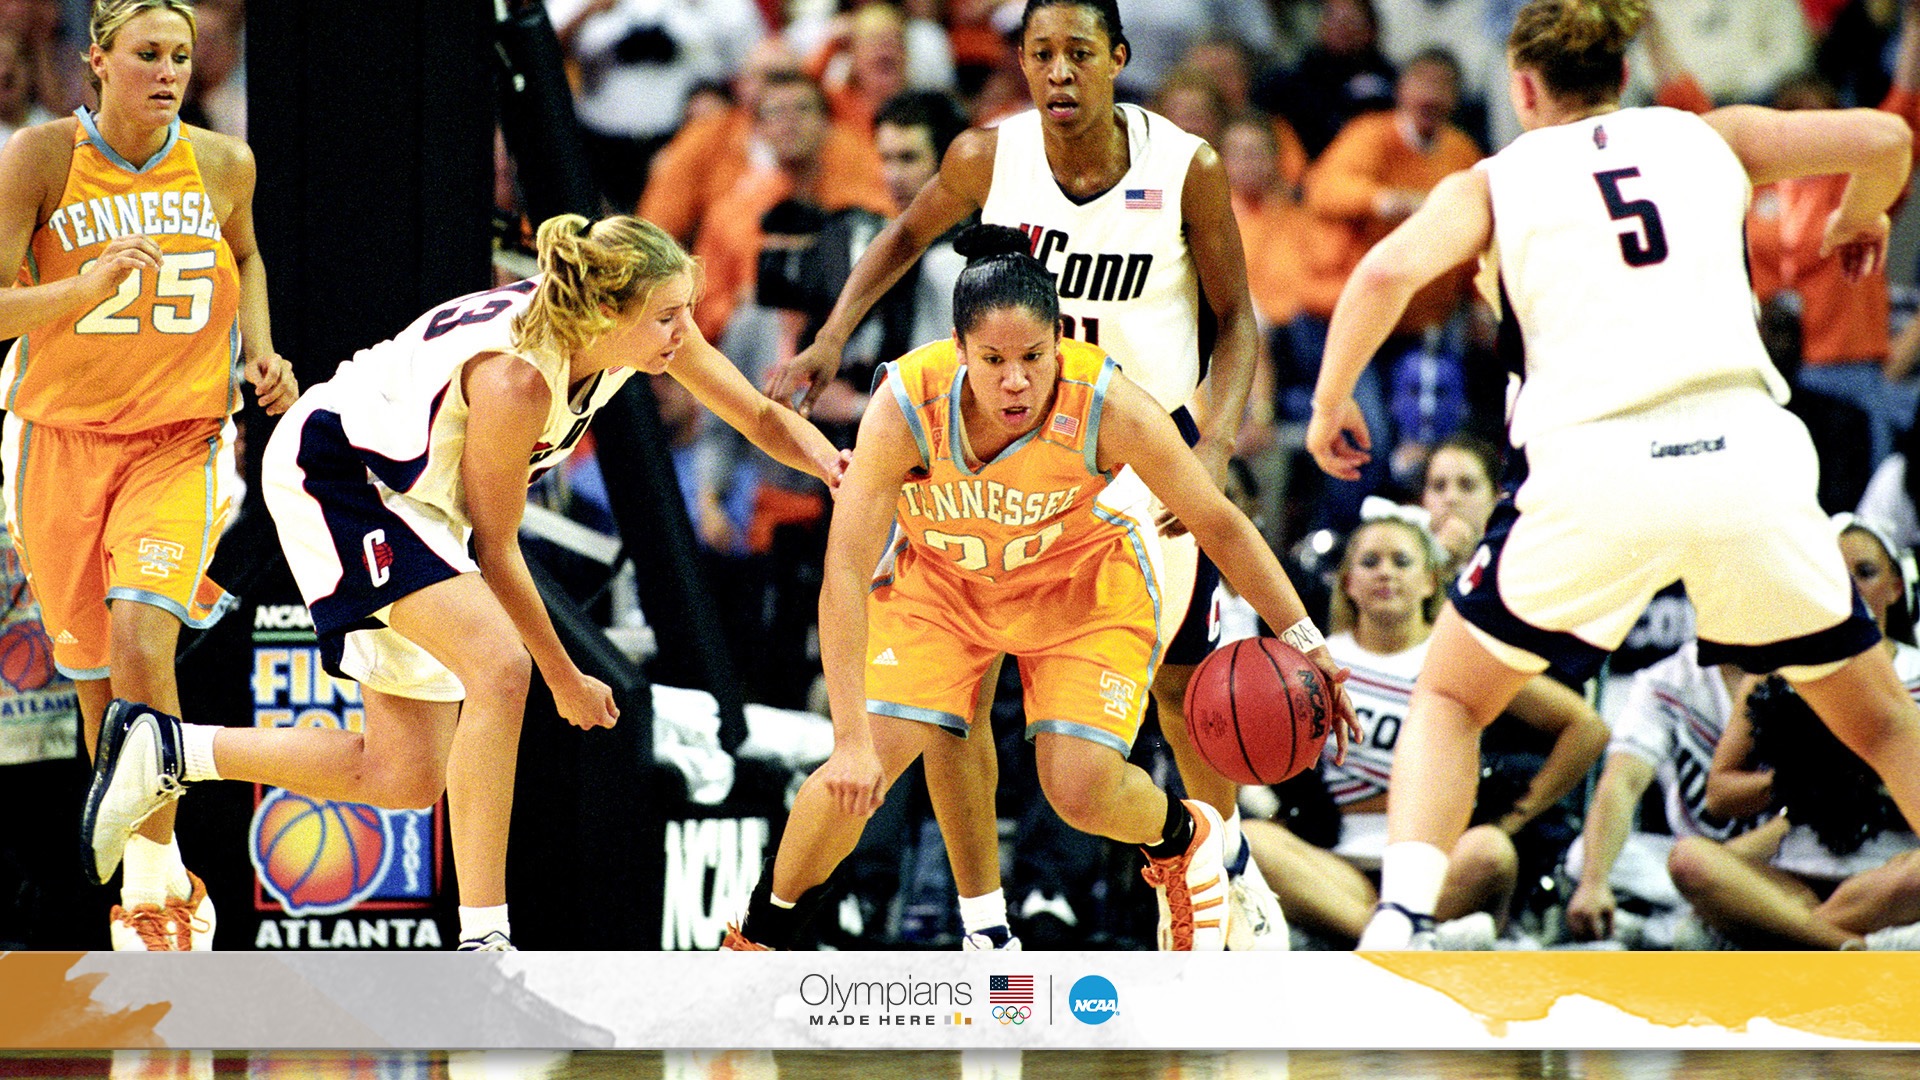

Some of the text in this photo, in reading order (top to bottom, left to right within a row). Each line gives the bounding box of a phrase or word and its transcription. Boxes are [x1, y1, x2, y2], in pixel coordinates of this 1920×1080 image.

[48, 191, 221, 252] TENNESSE
[1593, 166, 1668, 268] 5
[74, 250, 216, 334] 25
[254, 604, 316, 629] NCA
[251, 648, 363, 705] FIN
[254, 918, 443, 949] ATLANTA
